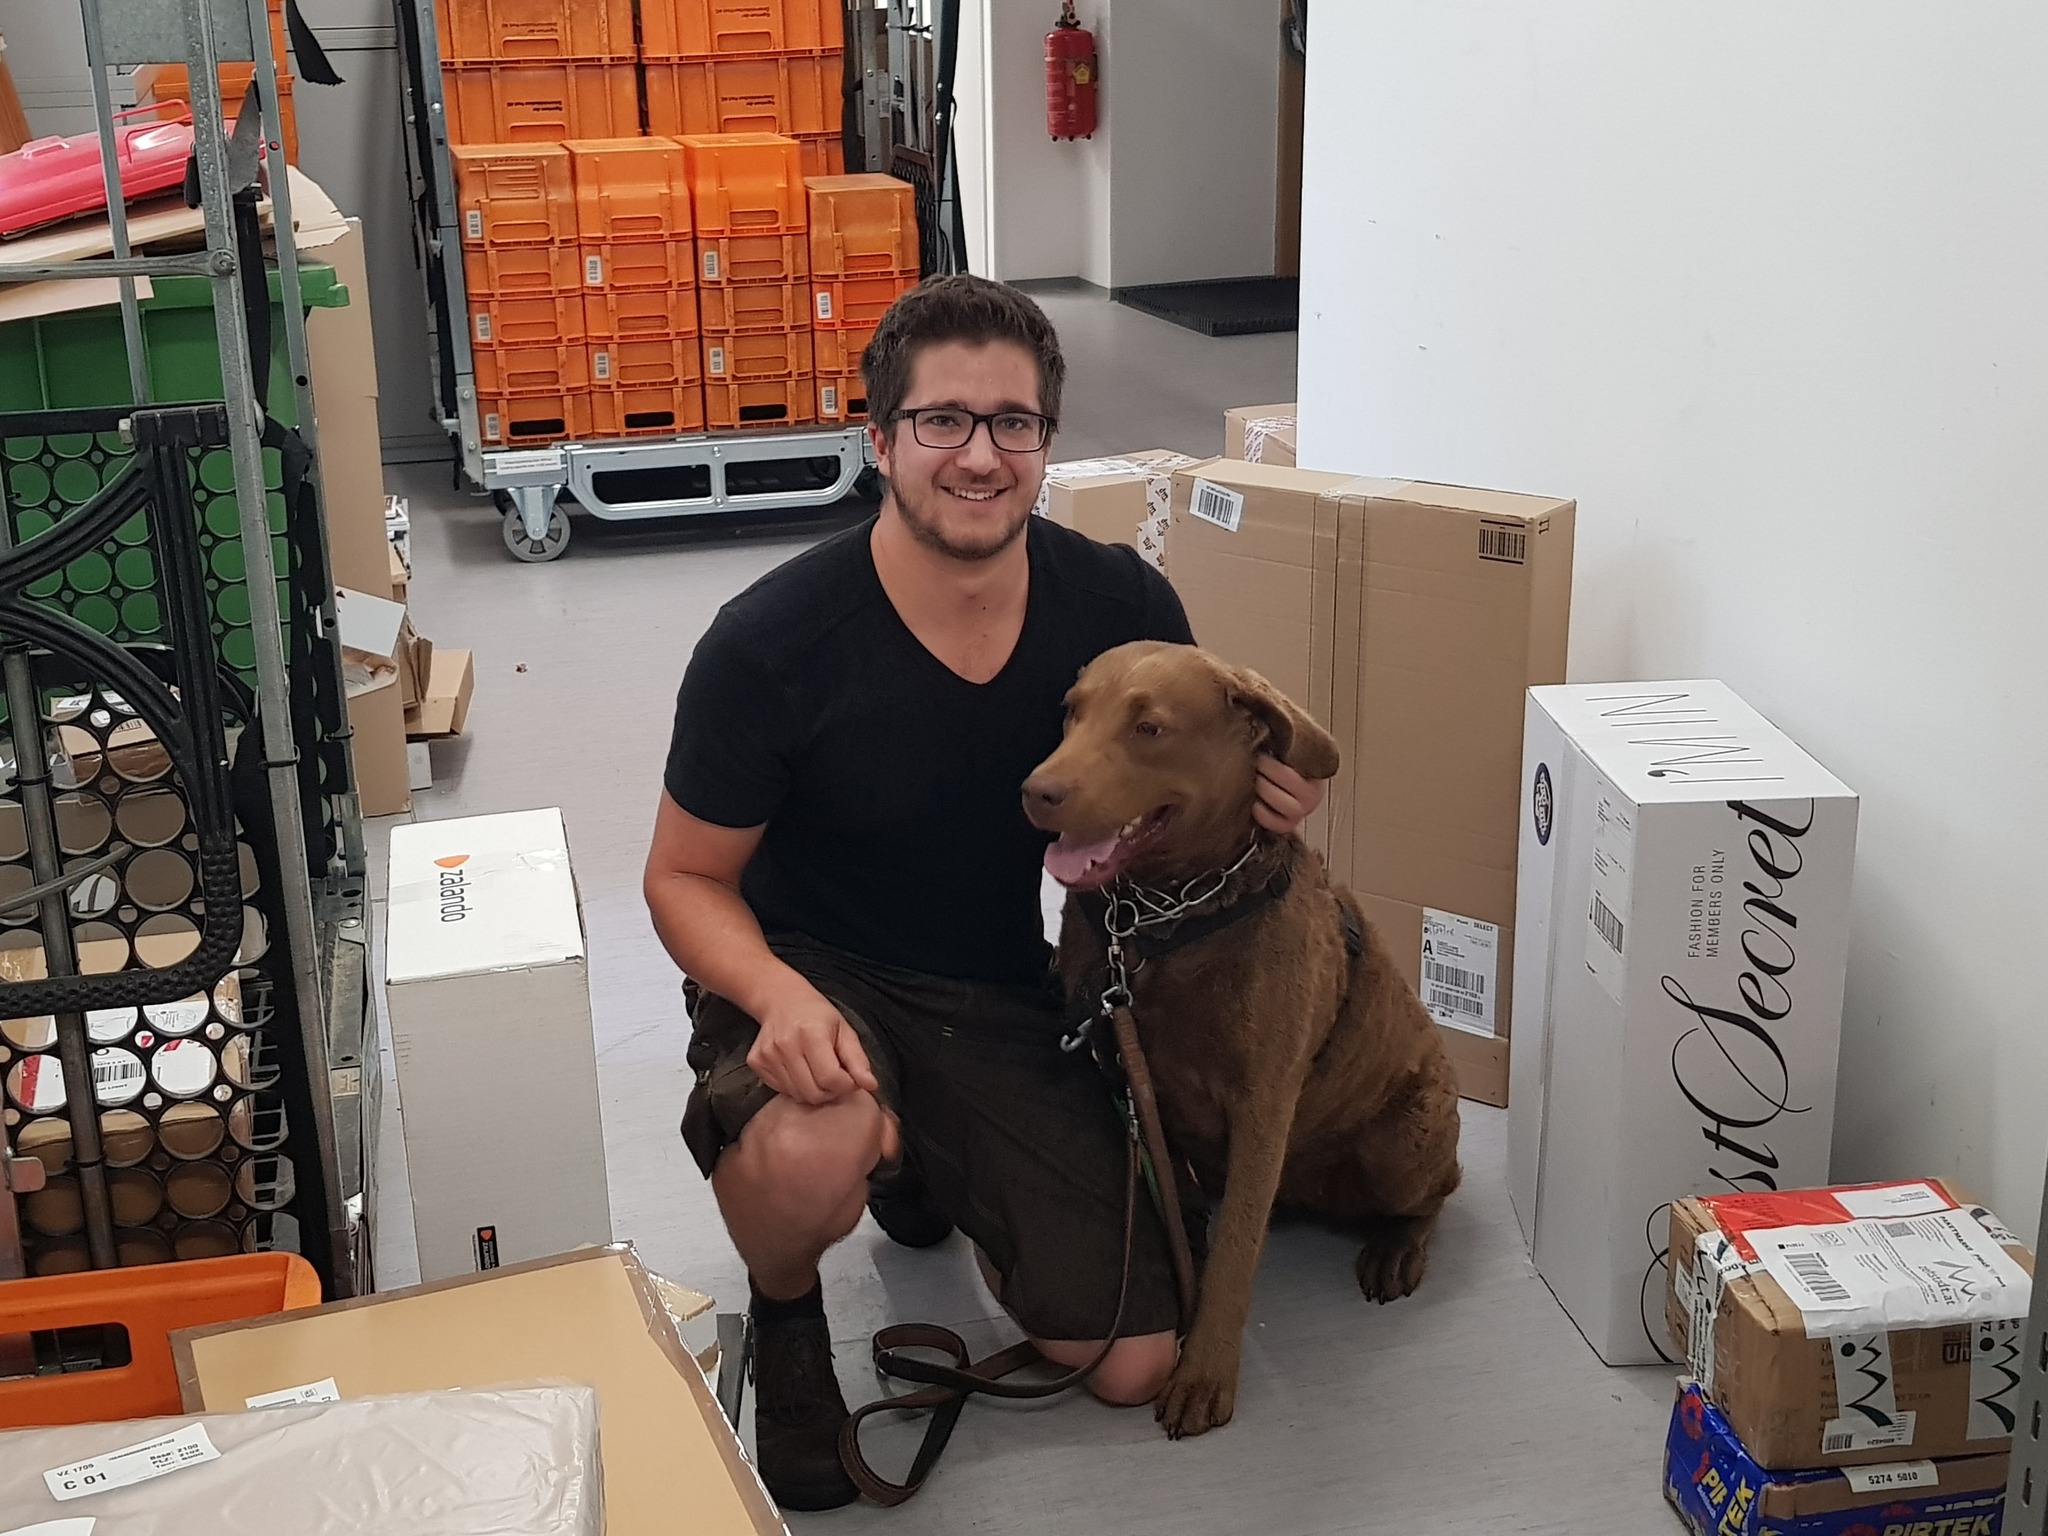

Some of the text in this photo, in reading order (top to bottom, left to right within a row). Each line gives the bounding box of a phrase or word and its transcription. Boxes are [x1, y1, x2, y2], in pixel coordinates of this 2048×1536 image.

[440, 869, 473, 923] zalando
[1706, 849, 1725, 958] MEMBERS ONLY
[1688, 865, 1705, 958] FASHION FOR
[1423, 939, 1433, 955] A
[57, 1468, 70, 1477] VZ
[63, 1472, 107, 1491] C 01
[1868, 1471, 1918, 1485] 5274 5010
